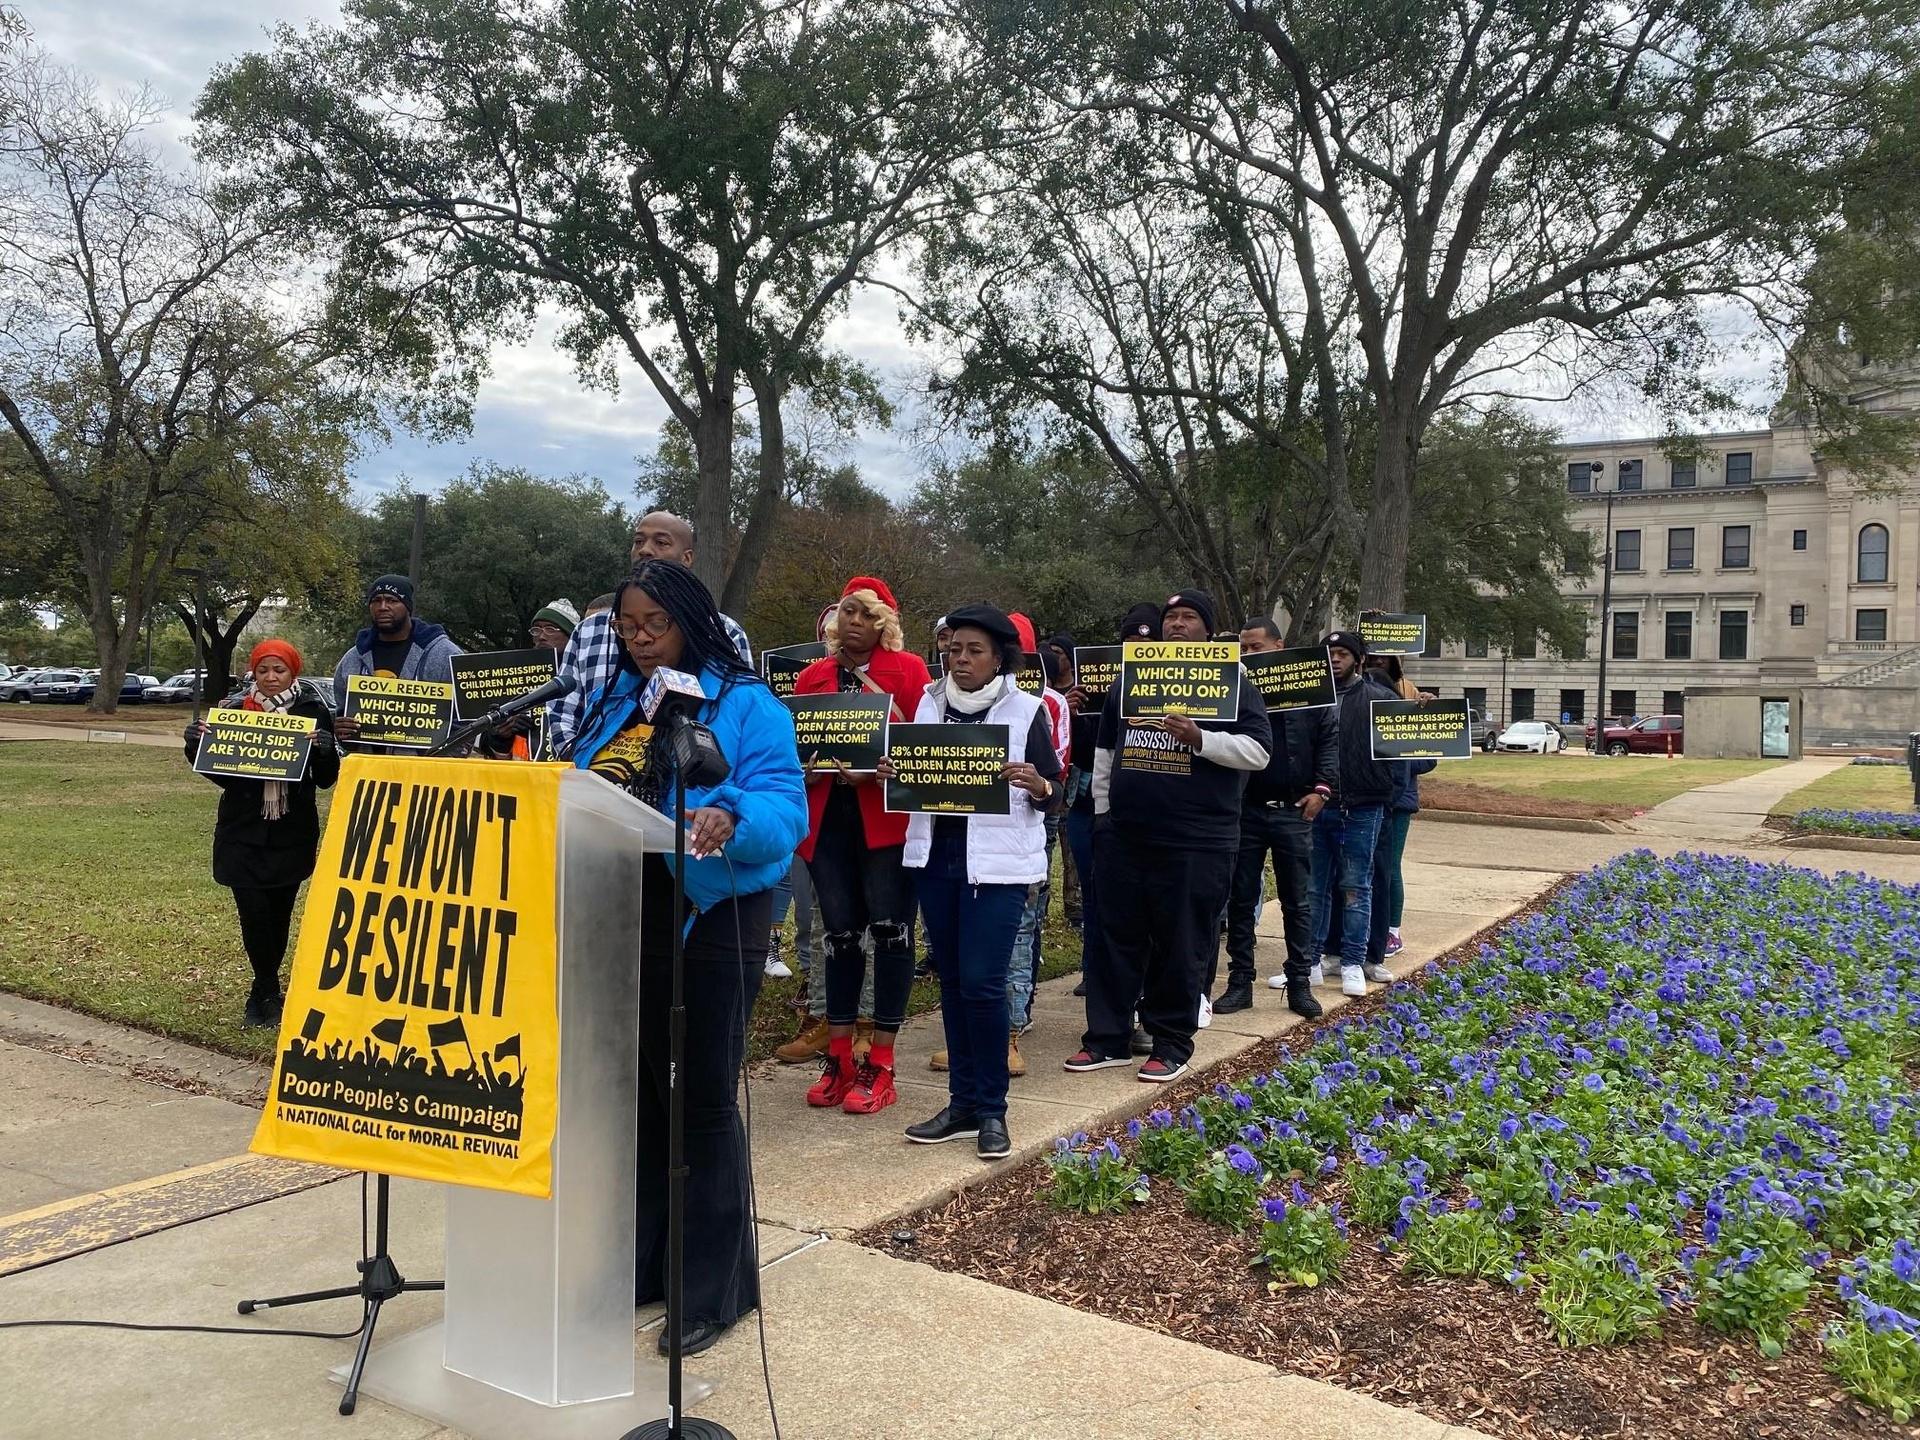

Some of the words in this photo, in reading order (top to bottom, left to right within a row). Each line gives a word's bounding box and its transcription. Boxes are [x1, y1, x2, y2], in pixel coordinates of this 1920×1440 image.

[1134, 647, 1170, 658] GOV.
[1175, 647, 1230, 659] REEVES
[457, 671, 476, 680] 58%
[478, 670, 490, 678] OF
[492, 664, 554, 676] MISSISSIPPI'S
[1080, 664, 1098, 673] 58%
[1100, 664, 1112, 672] OF
[1136, 668, 1184, 680] WHICH
[1188, 668, 1222, 680] SIDE
[1256, 668, 1268, 676] OF
[1270, 660, 1327, 674] MISSISSIPPI'S
[460, 678, 504, 690] CHILDREN
[506, 677, 524, 686] ARE
[526, 674, 552, 684] POOR
[772, 672, 791, 681] 58%
[792, 672, 799, 680] O
[1082, 675, 1119, 683] CHILDRE
[1250, 675, 1280, 686] ILDREN
[1283, 674, 1300, 682] ARE
[1302, 669, 1327, 679] POOR
[359, 680, 392, 692] GOV.
[397, 684, 444, 697] REEVES
[466, 691, 479, 700] OR
[481, 685, 541, 698] LOW-INCO
[775, 684, 796, 692] CHIL
[1085, 684, 1099, 693] OR
[1130, 684, 1156, 696] ARE
[1160, 684, 1192, 697] YOU
[1197, 686, 1230, 698] ON?
[1260, 679, 1320, 694] LOW-INCOME!
[360, 698, 404, 712] WHICH
[408, 702, 437, 714] SIDE
[218, 712, 251, 724] GOV.
[256, 716, 304, 730] REEVES
[354, 712, 378, 724] ARE
[382, 715, 412, 728] YOU
[414, 718, 443, 730] ON?
[797, 712, 812, 720] OF
[813, 710, 884, 720] MISSISSIPPI'S
[1375, 716, 1393, 724] 58%
[1408, 713, 1466, 722] MISSISSIPPI'S
[796, 722, 824, 732] DREN
[826, 722, 846, 731] ARE
[849, 722, 880, 731] POOR
[1377, 724, 1418, 732] CHILDREN
[1439, 722, 1464, 730] POOR
[216, 729, 262, 744] WHICH
[266, 734, 295, 747] SIDE
[797, 734, 870, 744] LOW-INCOME!
[1397, 732, 1457, 740] LOW-INCOME!
[207, 743, 234, 756] ARE
[238, 746, 268, 759] YOU
[271, 750, 300, 762] ON?
[890, 746, 912, 756] 58%
[914, 746, 928, 756] OF
[930, 746, 1005, 758] MISSISSIPPI'S
[1133, 748, 1158, 760] PEOPLE'S
[1158, 751, 1192, 764] CAMPAIGN
[892, 760, 944, 770] CHILDREN
[946, 760, 966, 771] ARE
[969, 761, 1000, 772] POOR
[900, 773, 915, 784] OR
[918, 774, 992, 785] LOW-INCOME!
[339, 779, 402, 884] WE
[398, 784, 517, 901] WON'T
[318, 887, 382, 996] BE
[374, 894, 518, 1018] SILENT
[283, 1072, 331, 1099] Poor
[334, 1080, 409, 1112] People's
[414, 1094, 520, 1133] Campaign
[277, 1106, 284, 1120] A
[286, 1108, 350, 1132] NATIONAL
[352, 1118, 382, 1138] CALL
[386, 1126, 406, 1141] for
[409, 1129, 459, 1150] MORAL
[463, 1139, 518, 1160] REVIVAL
